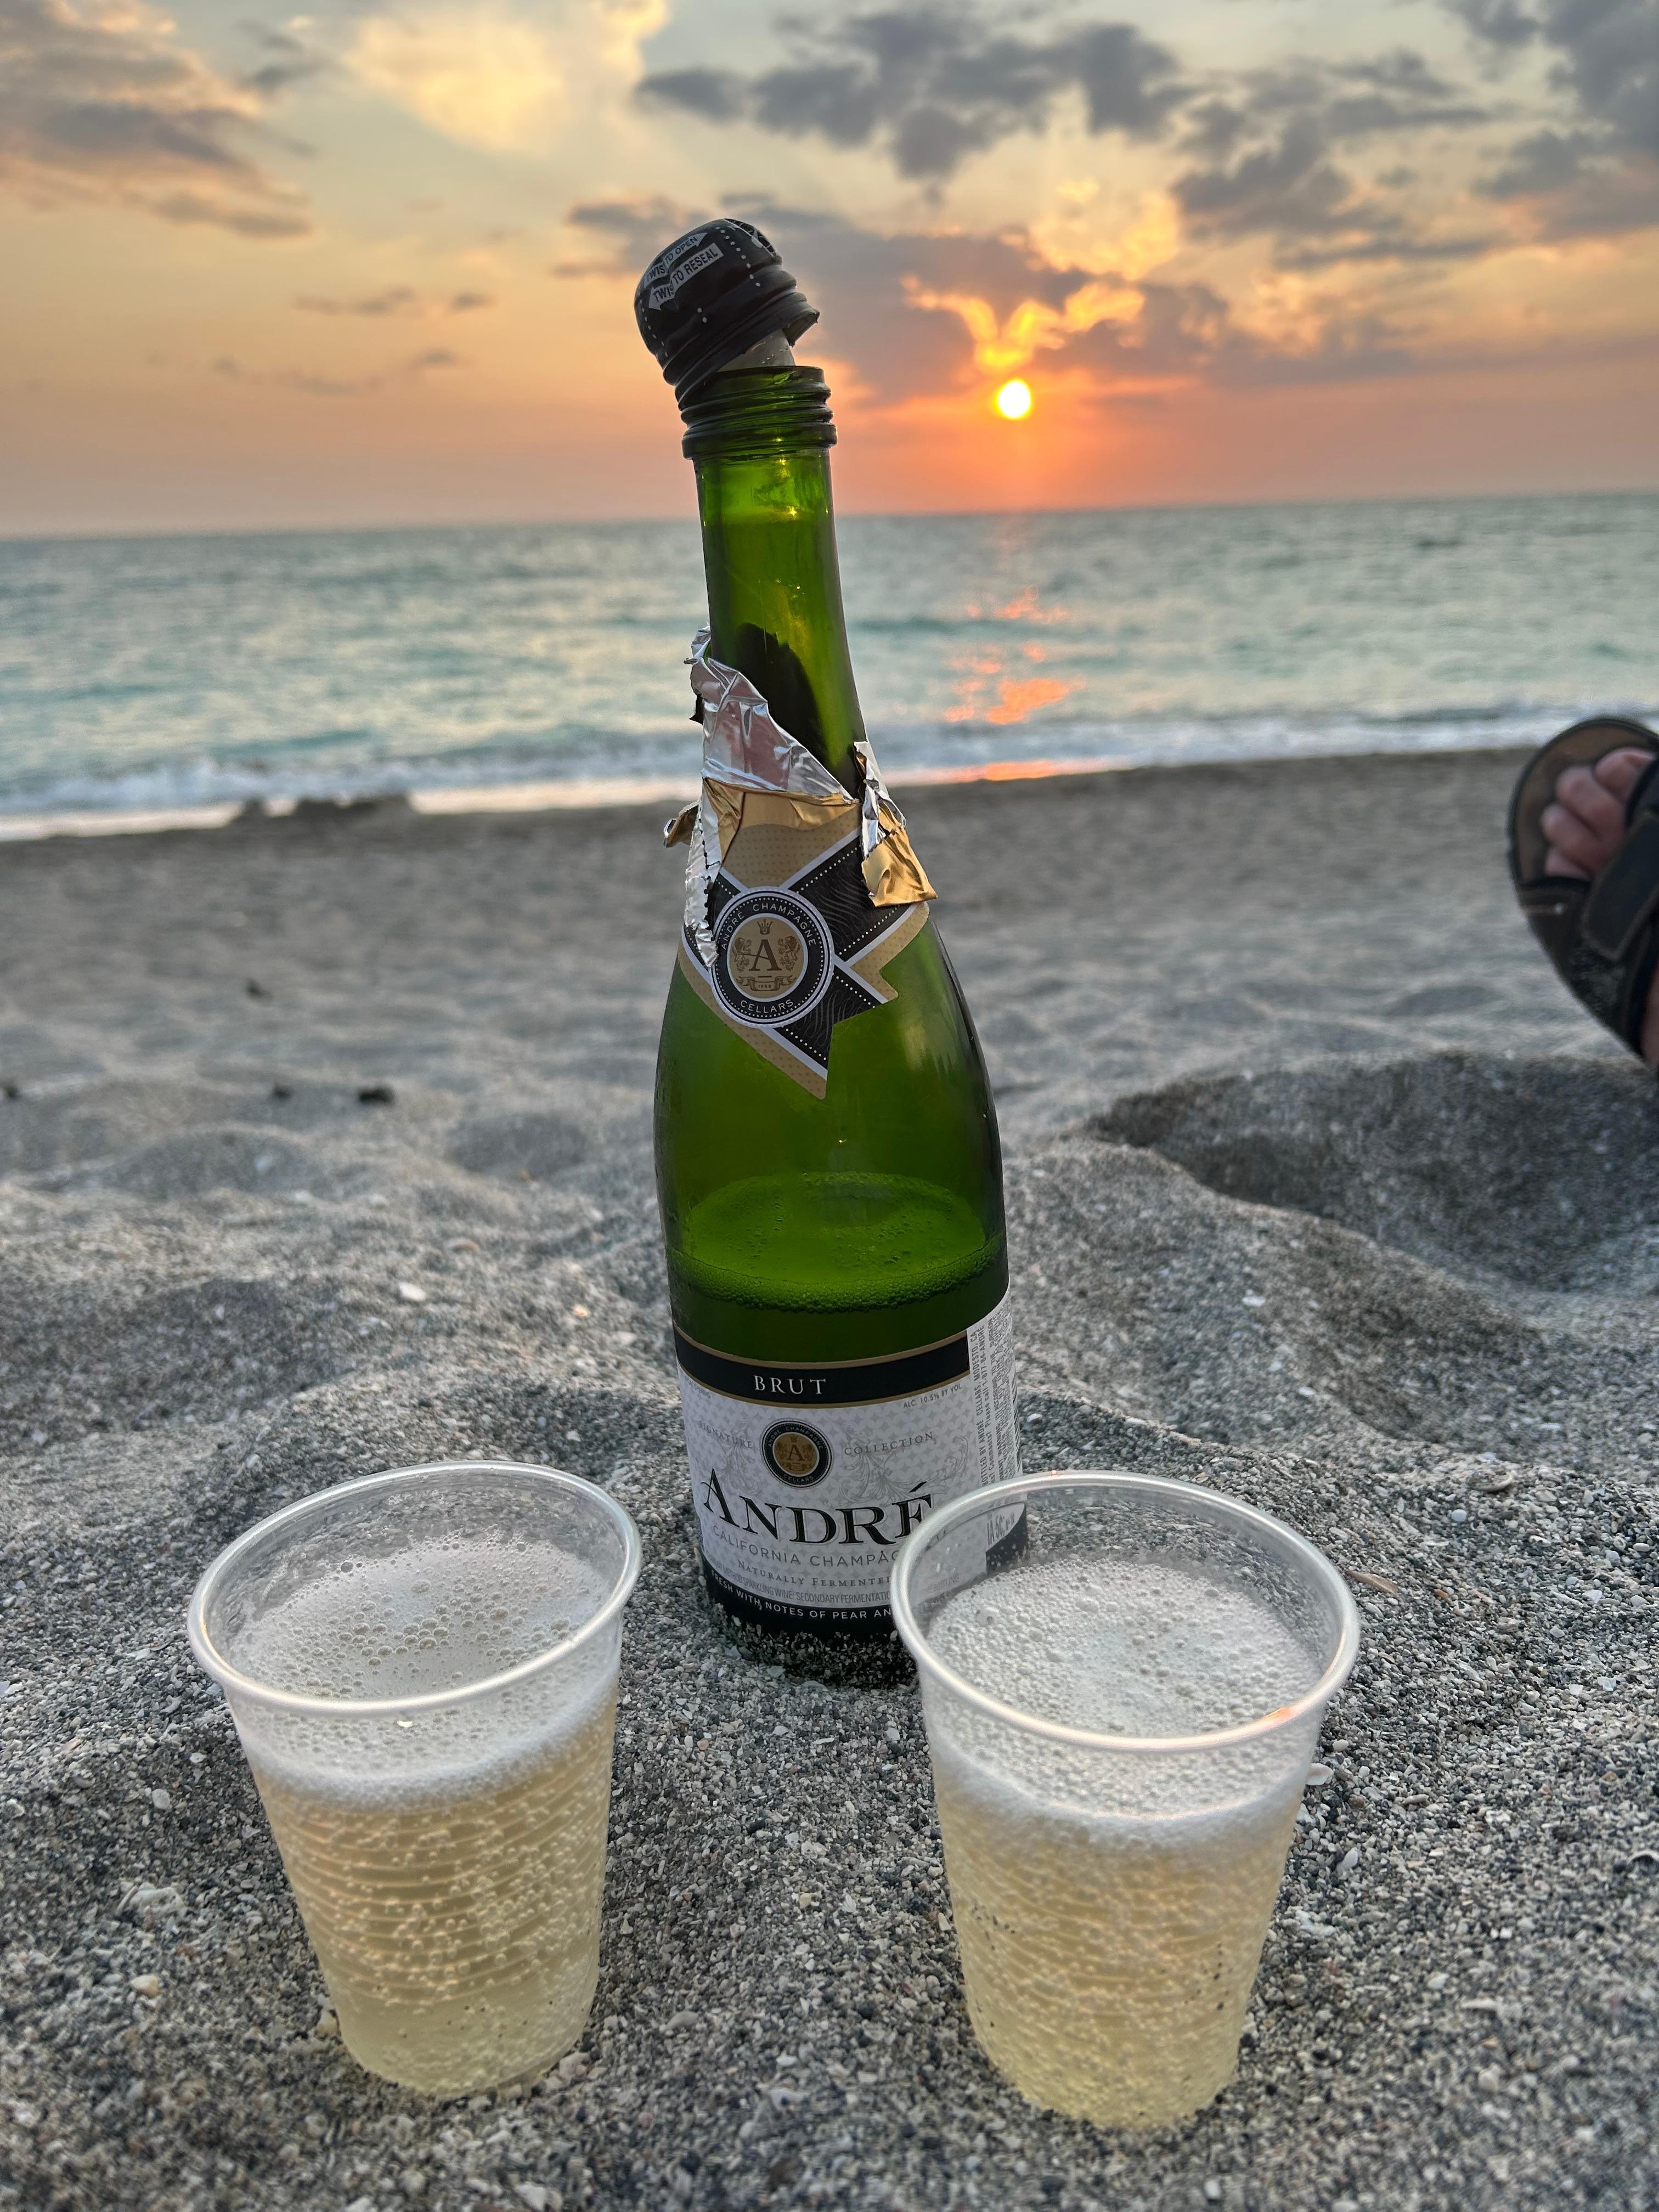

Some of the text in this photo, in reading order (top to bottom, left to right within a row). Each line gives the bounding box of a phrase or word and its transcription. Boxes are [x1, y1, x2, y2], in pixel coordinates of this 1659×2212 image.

[664, 253, 674, 264] TO
[675, 236, 698, 255] OPEN
[672, 270, 684, 284] TO
[684, 249, 719, 275] RESEAL
[753, 902, 816, 946] CHAMPAGNE
[746, 939, 782, 972] A
[741, 999, 793, 1013] CELLARS
[753, 1374, 826, 1395] BRUT
[920, 1392, 940, 1404] 10.5%
[941, 1389, 948, 1397] BY
[785, 1426, 823, 1449] CHAMPAGNE
[844, 1431, 934, 1455] COLLECTION
[787, 1444, 806, 1461] A
[979, 1445, 986, 1456] BY
[701, 1468, 932, 1545] ANDRÉ
[713, 1525, 801, 1565] CALIFORNIA
[738, 1560, 805, 1585] NATURALLY
[712, 1570, 733, 1593] FRESH
[765, 1601, 804, 1617] NOTES
[809, 1610, 826, 1618] OF
[832, 1611, 867, 1619] PEAR
[796, 1591, 839, 1603] SECONDARY
